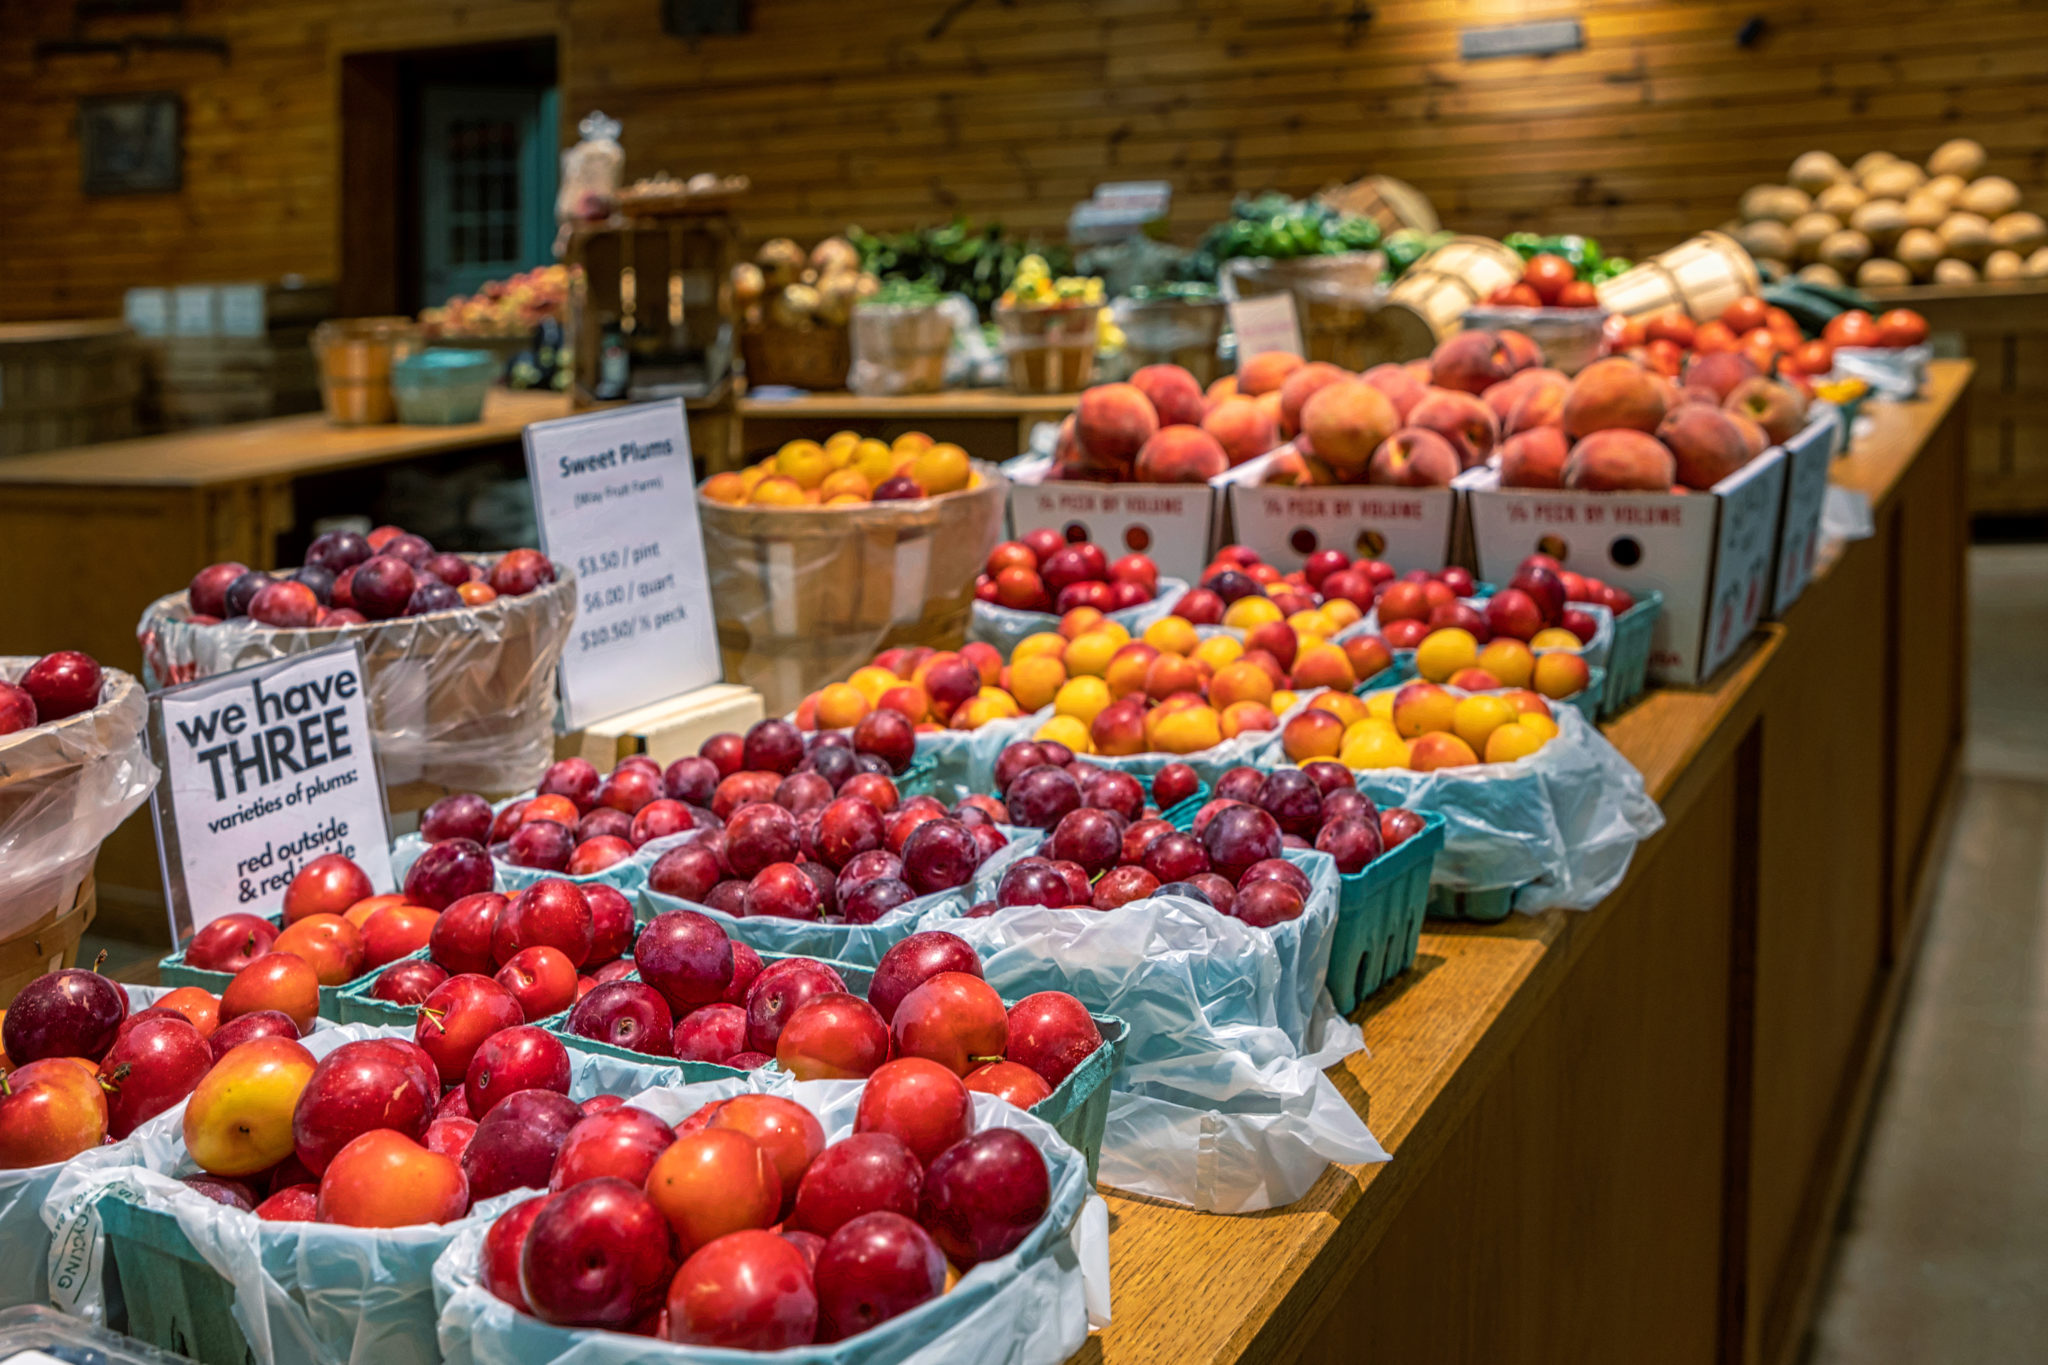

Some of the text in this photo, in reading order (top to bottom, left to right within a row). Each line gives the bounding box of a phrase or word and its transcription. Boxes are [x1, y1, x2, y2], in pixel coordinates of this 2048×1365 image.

[559, 439, 673, 478] Sweet Plums
[632, 475, 664, 492] Farm)
[1101, 496, 1118, 514] BY
[1125, 495, 1183, 516] VOLUME
[1334, 500, 1352, 518] BY
[1360, 500, 1422, 519] VOLUME
[1584, 504, 1603, 524] BY
[1614, 505, 1681, 526] VOLUME
[578, 550, 620, 578] $3.50
[632, 542, 660, 566] pint
[584, 585, 625, 614] $6.00
[637, 573, 674, 598] quart
[655, 604, 687, 631] peck
[176, 670, 358, 748] we have
[197, 705, 352, 801] THREE
[208, 769, 358, 834] varieties of plums:
[237, 841, 273, 877] red
[277, 816, 348, 861] outside
[238, 860, 295, 903] & red
